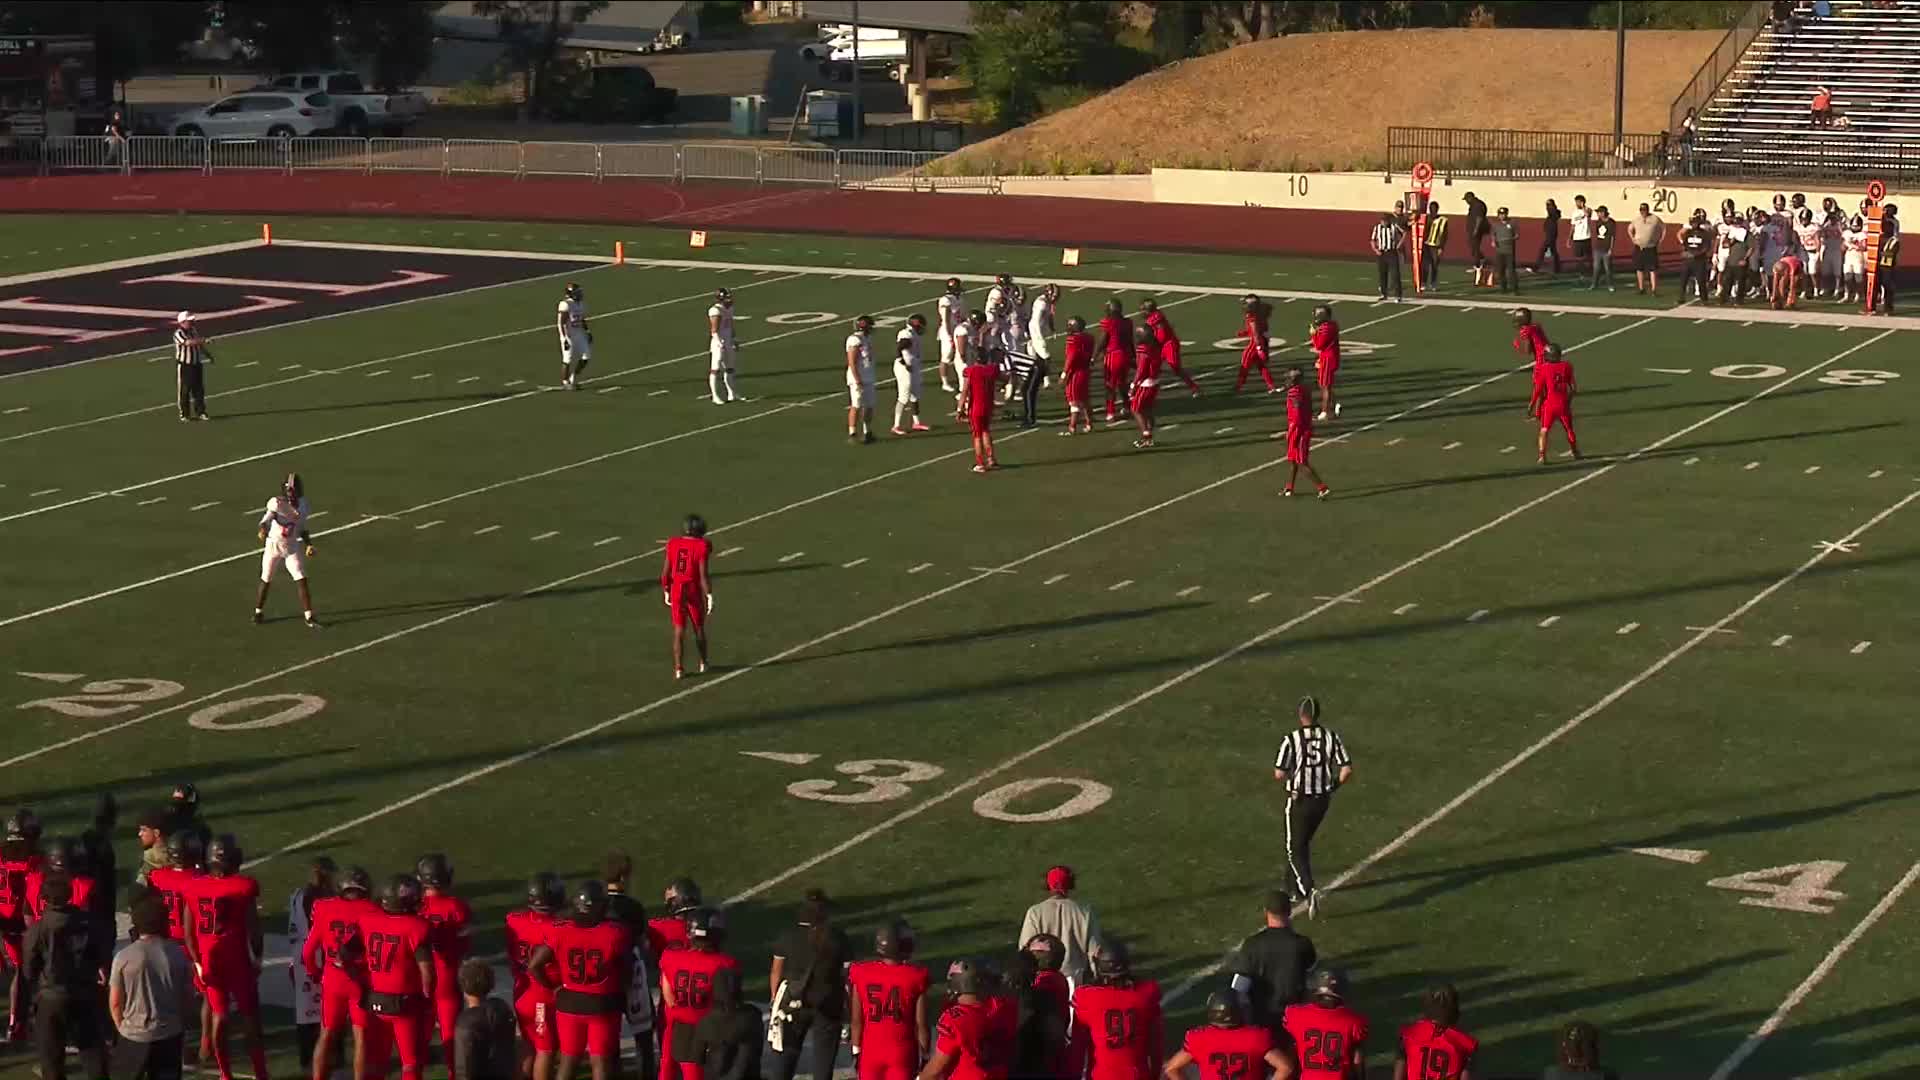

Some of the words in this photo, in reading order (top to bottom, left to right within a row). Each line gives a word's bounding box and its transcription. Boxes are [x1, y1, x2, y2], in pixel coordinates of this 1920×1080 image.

[1288, 175, 1308, 196] 10
[1653, 189, 1678, 213] 20
[1306, 738, 1323, 766] S
[786, 759, 1113, 823] 30
[1706, 860, 1849, 914] 4
[366, 930, 401, 973] 97
[567, 948, 606, 984] 93
[866, 983, 903, 1022] 54
[1104, 1008, 1137, 1050] 91
[1303, 1028, 1344, 1073] 29
[1419, 1046, 1450, 1080] 19
